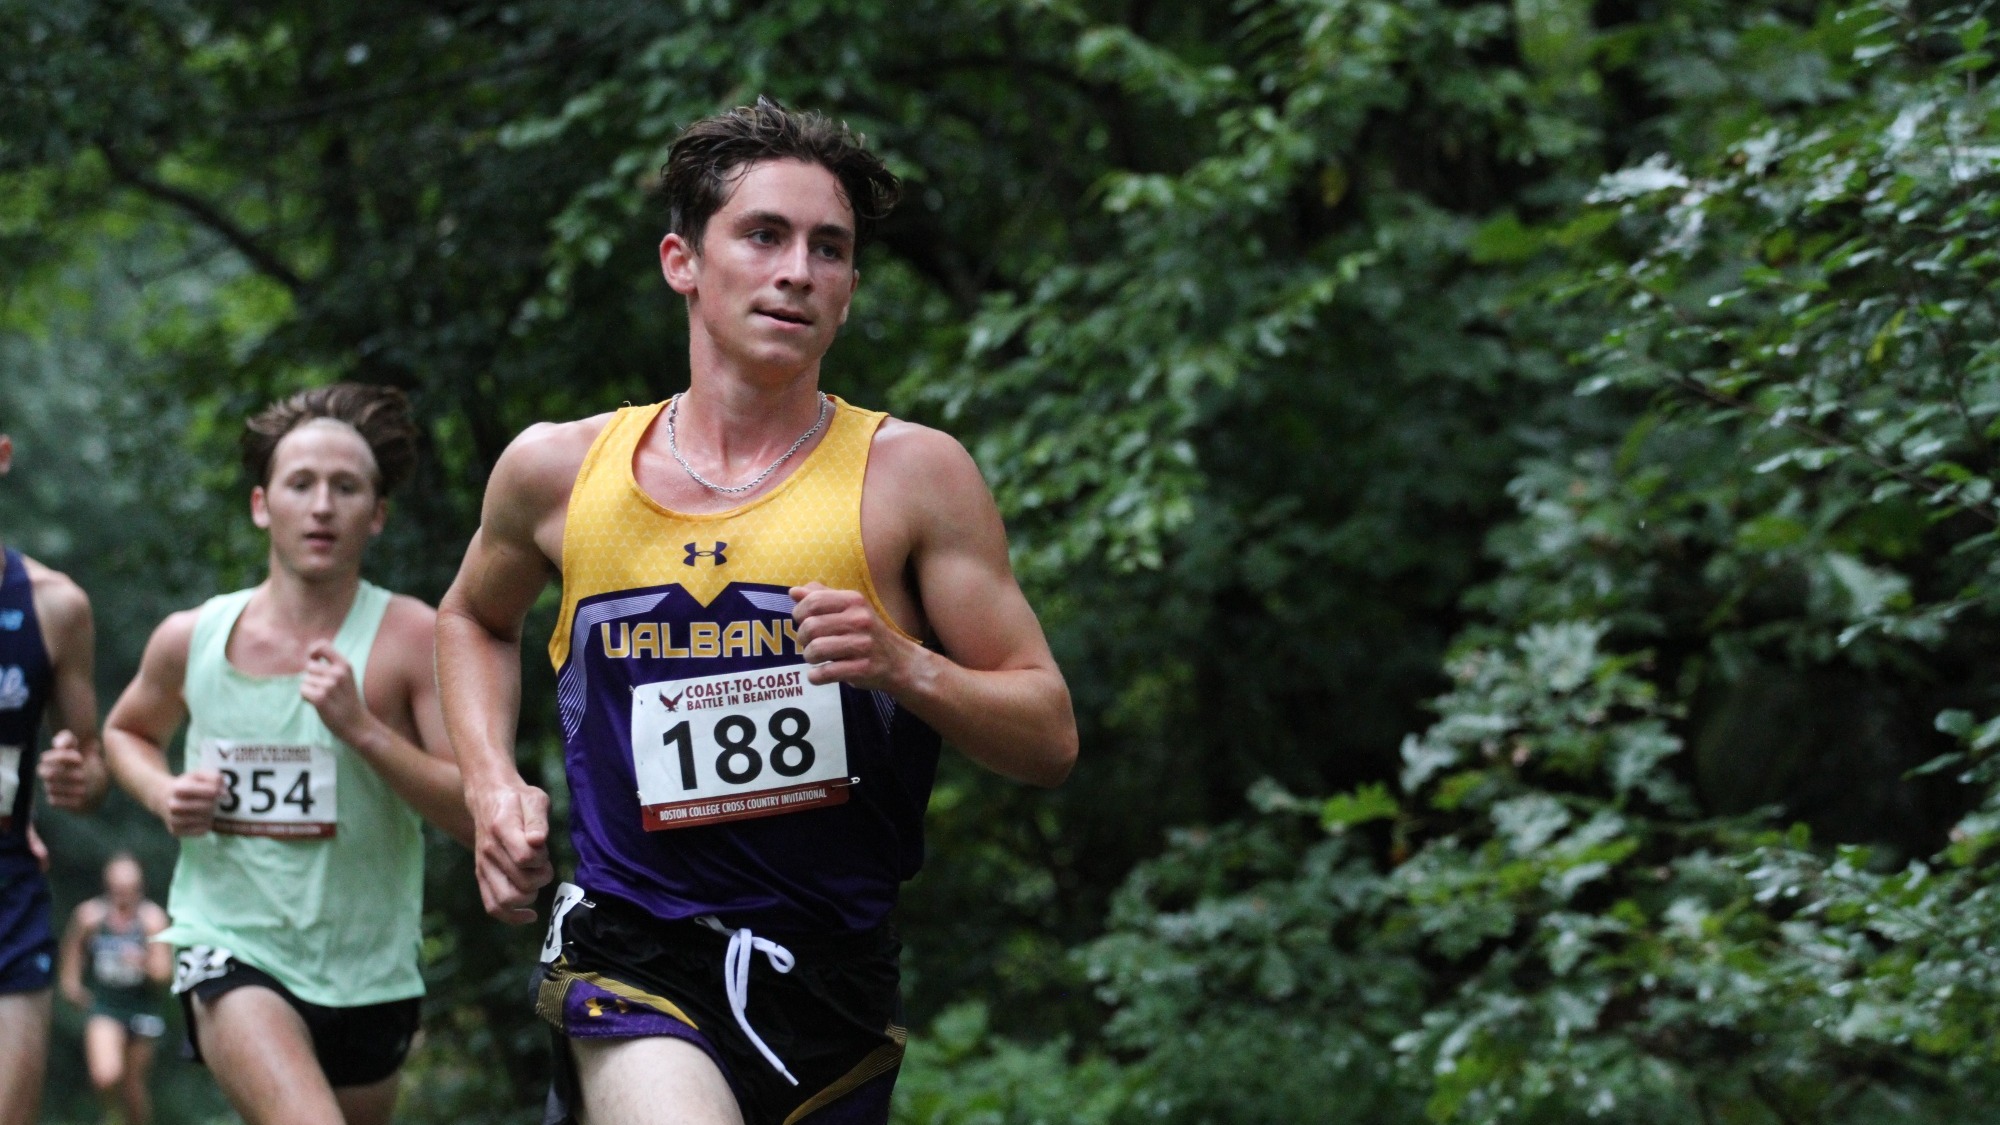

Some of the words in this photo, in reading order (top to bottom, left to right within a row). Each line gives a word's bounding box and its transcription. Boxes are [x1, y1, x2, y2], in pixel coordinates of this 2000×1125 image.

[601, 618, 803, 659] UALBANY
[685, 670, 801, 699] COAST-TO-COAST
[686, 696, 724, 711] BATTLE
[728, 694, 740, 706] IN
[743, 685, 803, 704] BEANTOWN
[662, 706, 816, 791] 188
[218, 768, 314, 815] 354
[660, 808, 688, 821] BOSTON
[688, 804, 721, 818] COLLEGE
[722, 800, 745, 813] CROSS
[746, 795, 780, 810] COUNTRY
[781, 788, 828, 805] INVITATIONAL
